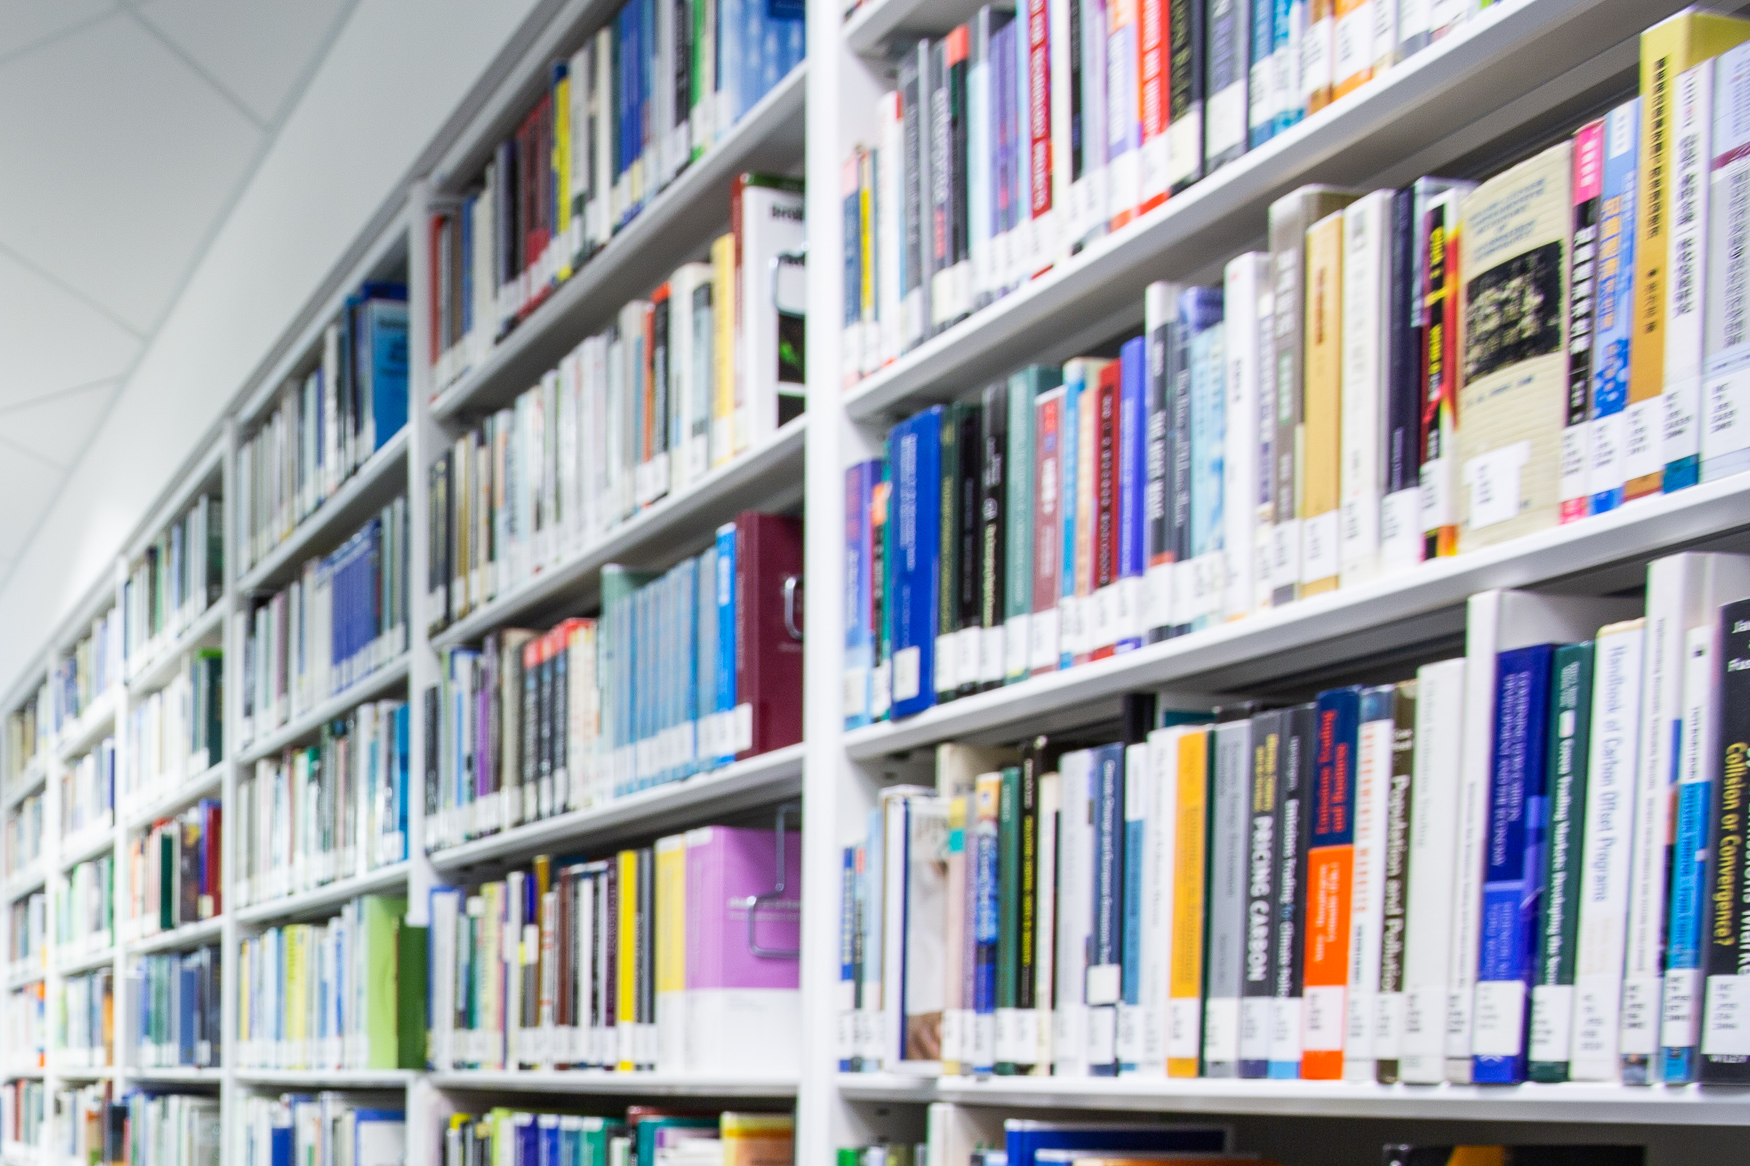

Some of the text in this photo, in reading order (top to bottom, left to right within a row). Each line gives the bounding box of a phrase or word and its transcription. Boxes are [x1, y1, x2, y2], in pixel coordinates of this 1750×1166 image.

[1712, 742, 1748, 945] Collision or Convergence?
